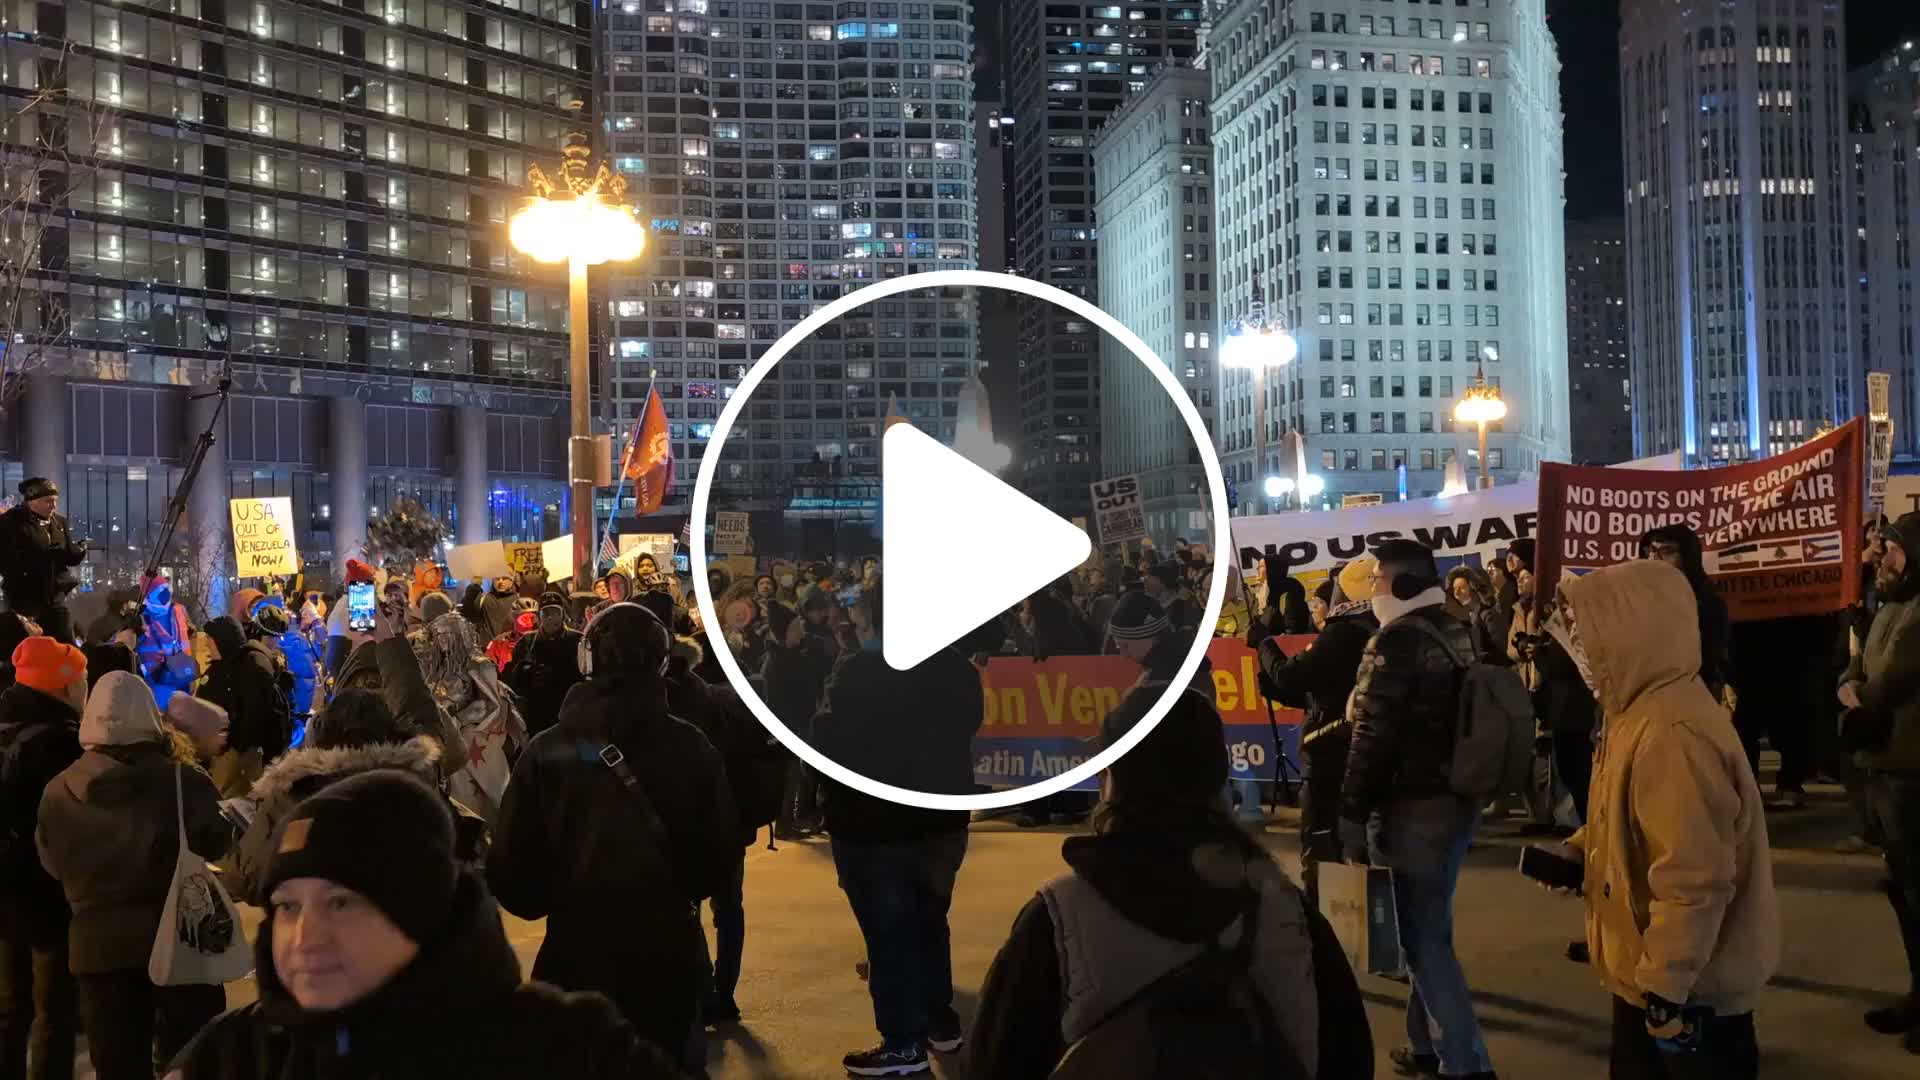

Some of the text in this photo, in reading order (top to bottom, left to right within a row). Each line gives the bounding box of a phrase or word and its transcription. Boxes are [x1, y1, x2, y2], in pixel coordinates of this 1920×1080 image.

[1567, 448, 1834, 508] NO BOOTS ON THE GROUND
[1094, 478, 1138, 498] US
[1098, 493, 1139, 510] OUT
[1565, 510, 1601, 534] NO
[1708, 504, 1734, 527] IN
[1741, 485, 1784, 516] THE
[1791, 473, 1835, 502] AIR
[236, 503, 274, 520] USA
[236, 523, 280, 537] OUT OF
[1564, 504, 1838, 561] U.S. OU VERYWHERE
[236, 539, 290, 554] VENEZUELA
[251, 554, 283, 568] NOW!
[974, 750, 1024, 776] atin
